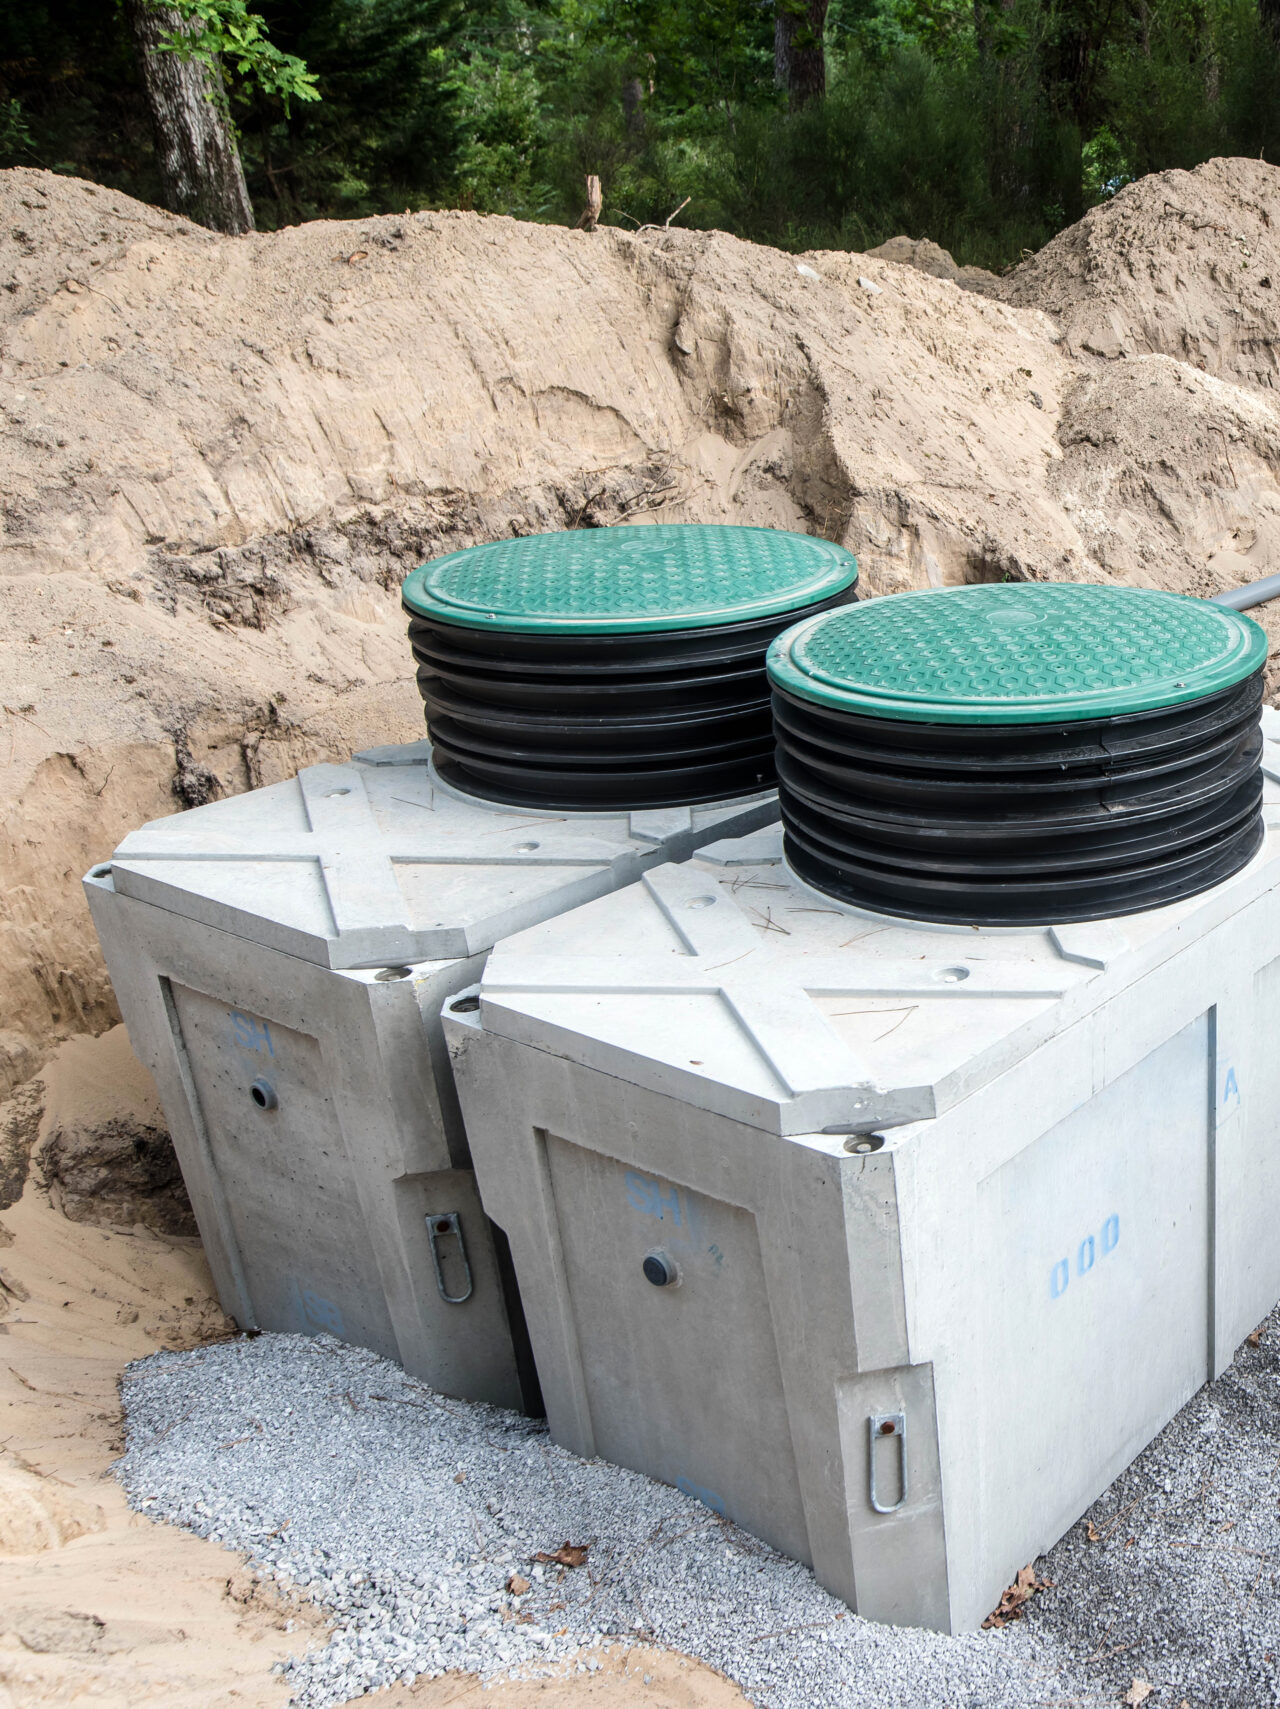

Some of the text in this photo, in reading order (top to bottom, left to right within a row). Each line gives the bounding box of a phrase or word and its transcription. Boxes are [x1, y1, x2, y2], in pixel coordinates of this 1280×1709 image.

[230, 1010, 275, 1058] SH
[1223, 1065, 1241, 1105] A
[624, 1171, 682, 1227] SH
